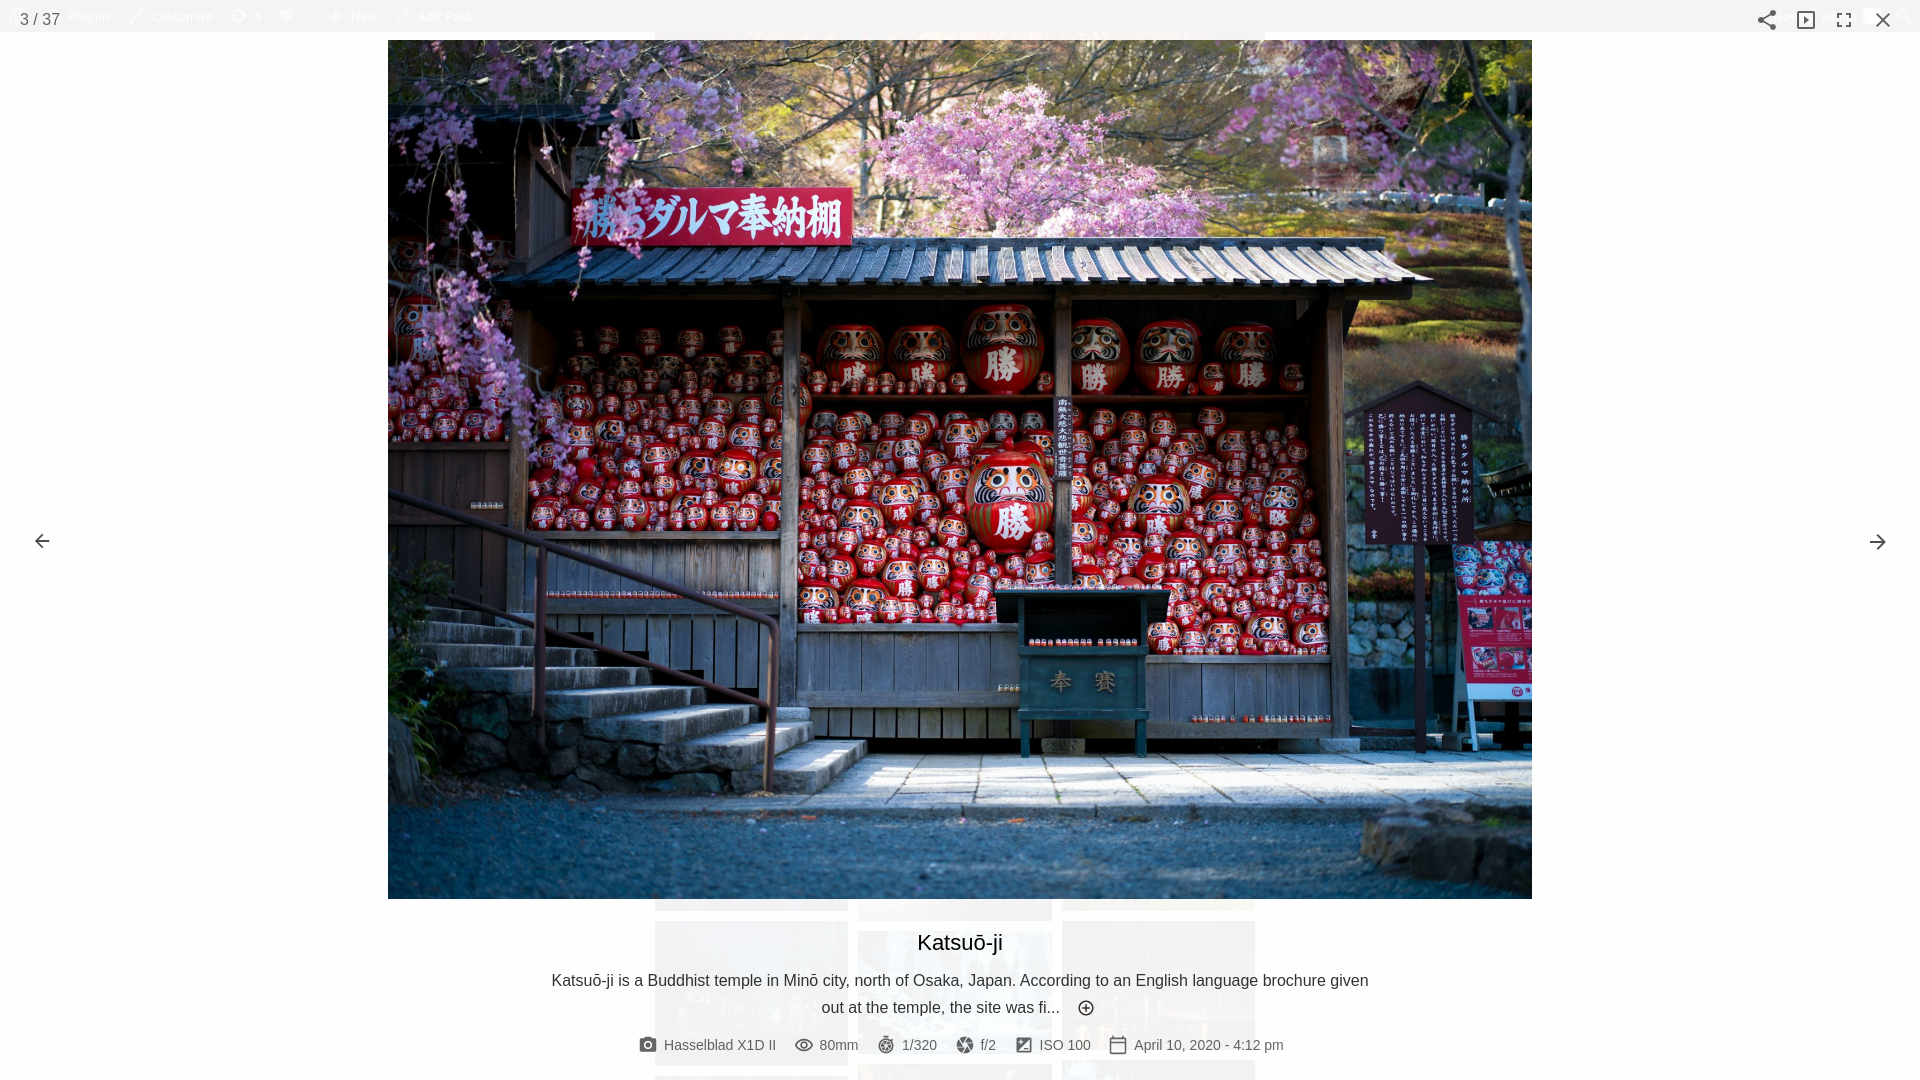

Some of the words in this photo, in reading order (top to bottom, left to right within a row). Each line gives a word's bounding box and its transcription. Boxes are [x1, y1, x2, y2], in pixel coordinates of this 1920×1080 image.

[984, 346, 1020, 381] 勝
[1081, 362, 1108, 391] 勝
[1157, 365, 1185, 388] 勝
[1237, 362, 1266, 388] 勝
[1460, 434, 1470, 503] 勝ちダルマ納め所
[994, 502, 1032, 541] 勝
